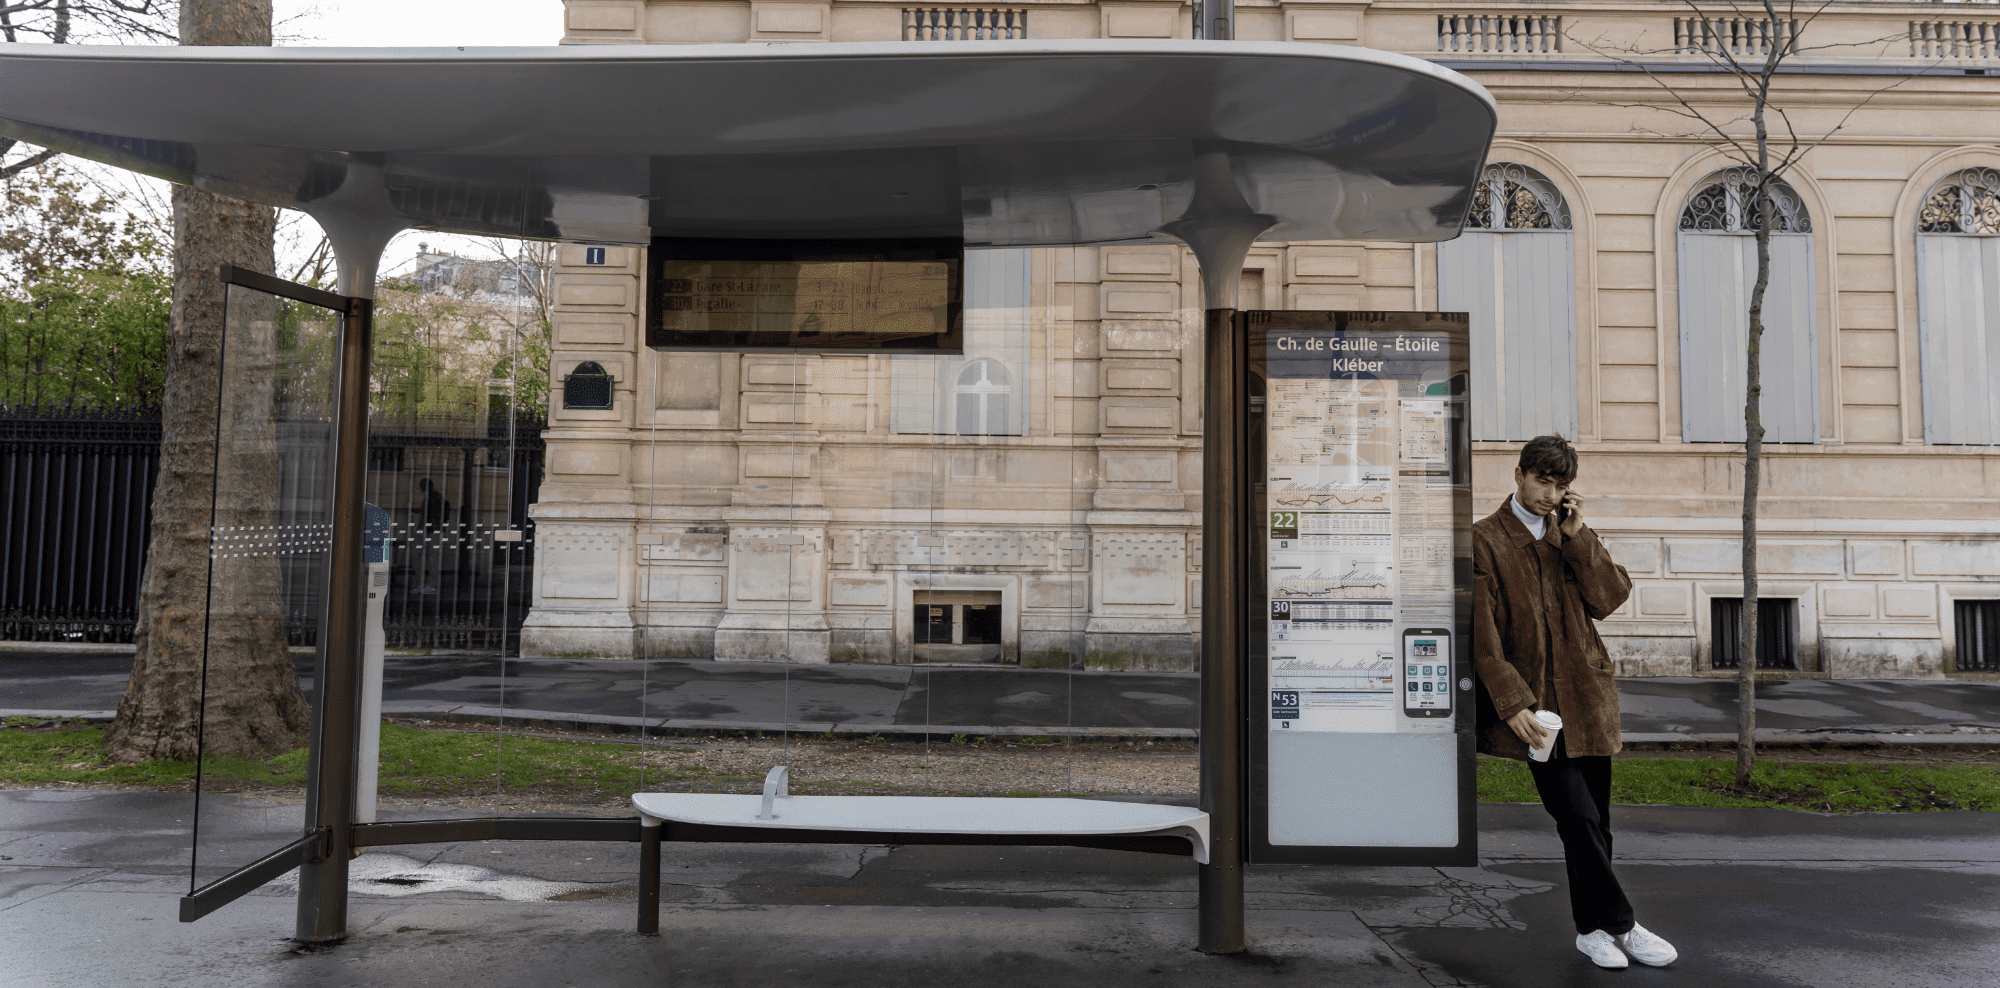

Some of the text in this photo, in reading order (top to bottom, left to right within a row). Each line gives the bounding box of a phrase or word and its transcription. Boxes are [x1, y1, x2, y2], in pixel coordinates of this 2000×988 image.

[670, 280, 684, 292] 22
[696, 281, 724, 292] Gare
[726, 281, 781, 292] St-Lazare
[696, 297, 737, 311] Pigalle
[1276, 336, 1302, 351] Ch.
[1305, 336, 1325, 351] de
[1329, 337, 1378, 351] Gaulle
[1395, 334, 1440, 352] Étoile
[1332, 358, 1384, 372] Kléber
[1273, 512, 1295, 528] 22
[1273, 601, 1289, 613] 30
[1281, 694, 1298, 706] 53
